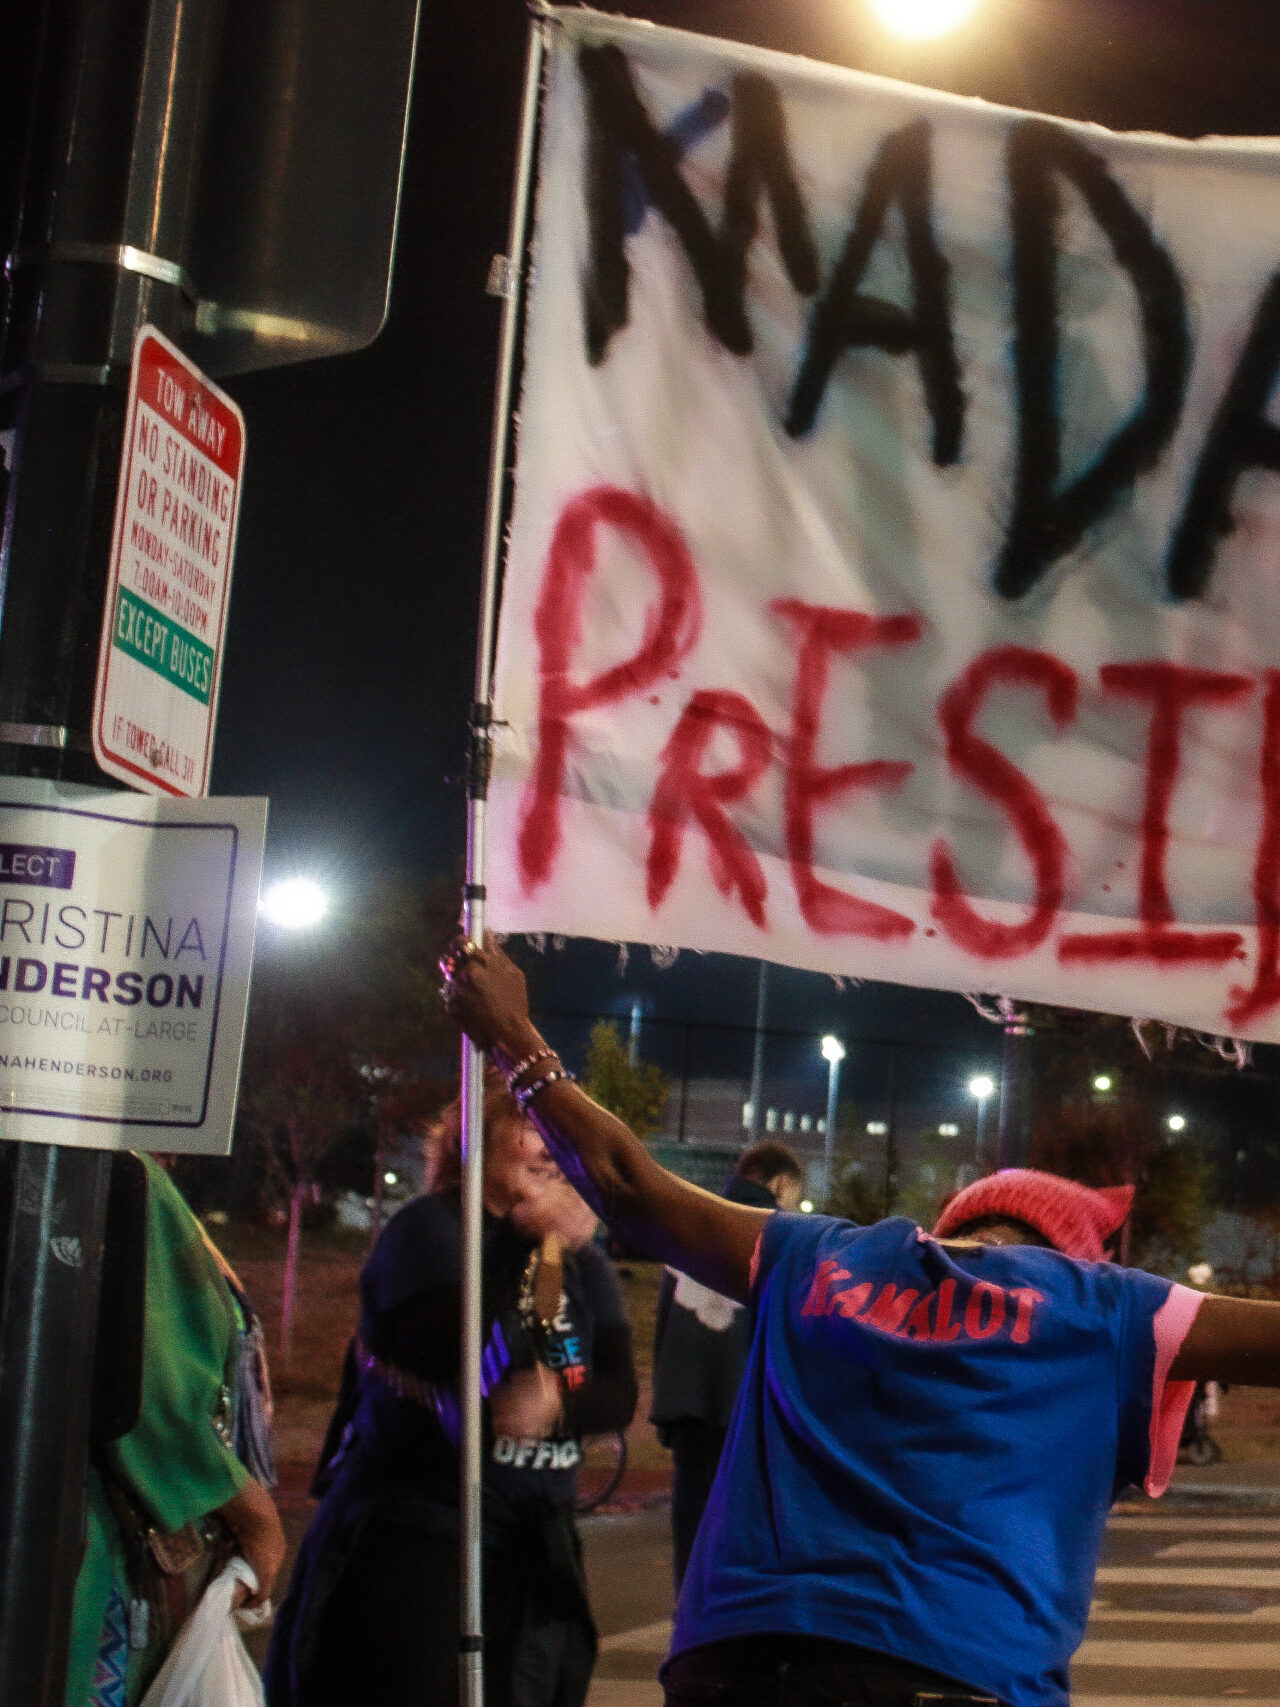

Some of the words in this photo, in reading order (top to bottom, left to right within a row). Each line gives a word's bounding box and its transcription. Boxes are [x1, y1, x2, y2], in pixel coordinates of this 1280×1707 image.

[157, 367, 186, 421] TOW
[187, 402, 228, 458] AWAY
[138, 414, 159, 463] NO
[163, 435, 230, 522] STANDING
[137, 469, 158, 518] OR
[162, 488, 221, 567] PARKING
[131, 520, 216, 606] MONDAY-SATURDAY
[117, 597, 169, 665] EXCEPT
[170, 634, 211, 695] BUSES
[0, 898, 206, 961] RISTINA
[96, 1018, 198, 1042] AT-LARGE
[801, 1260, 1044, 1343] KAMALOT
